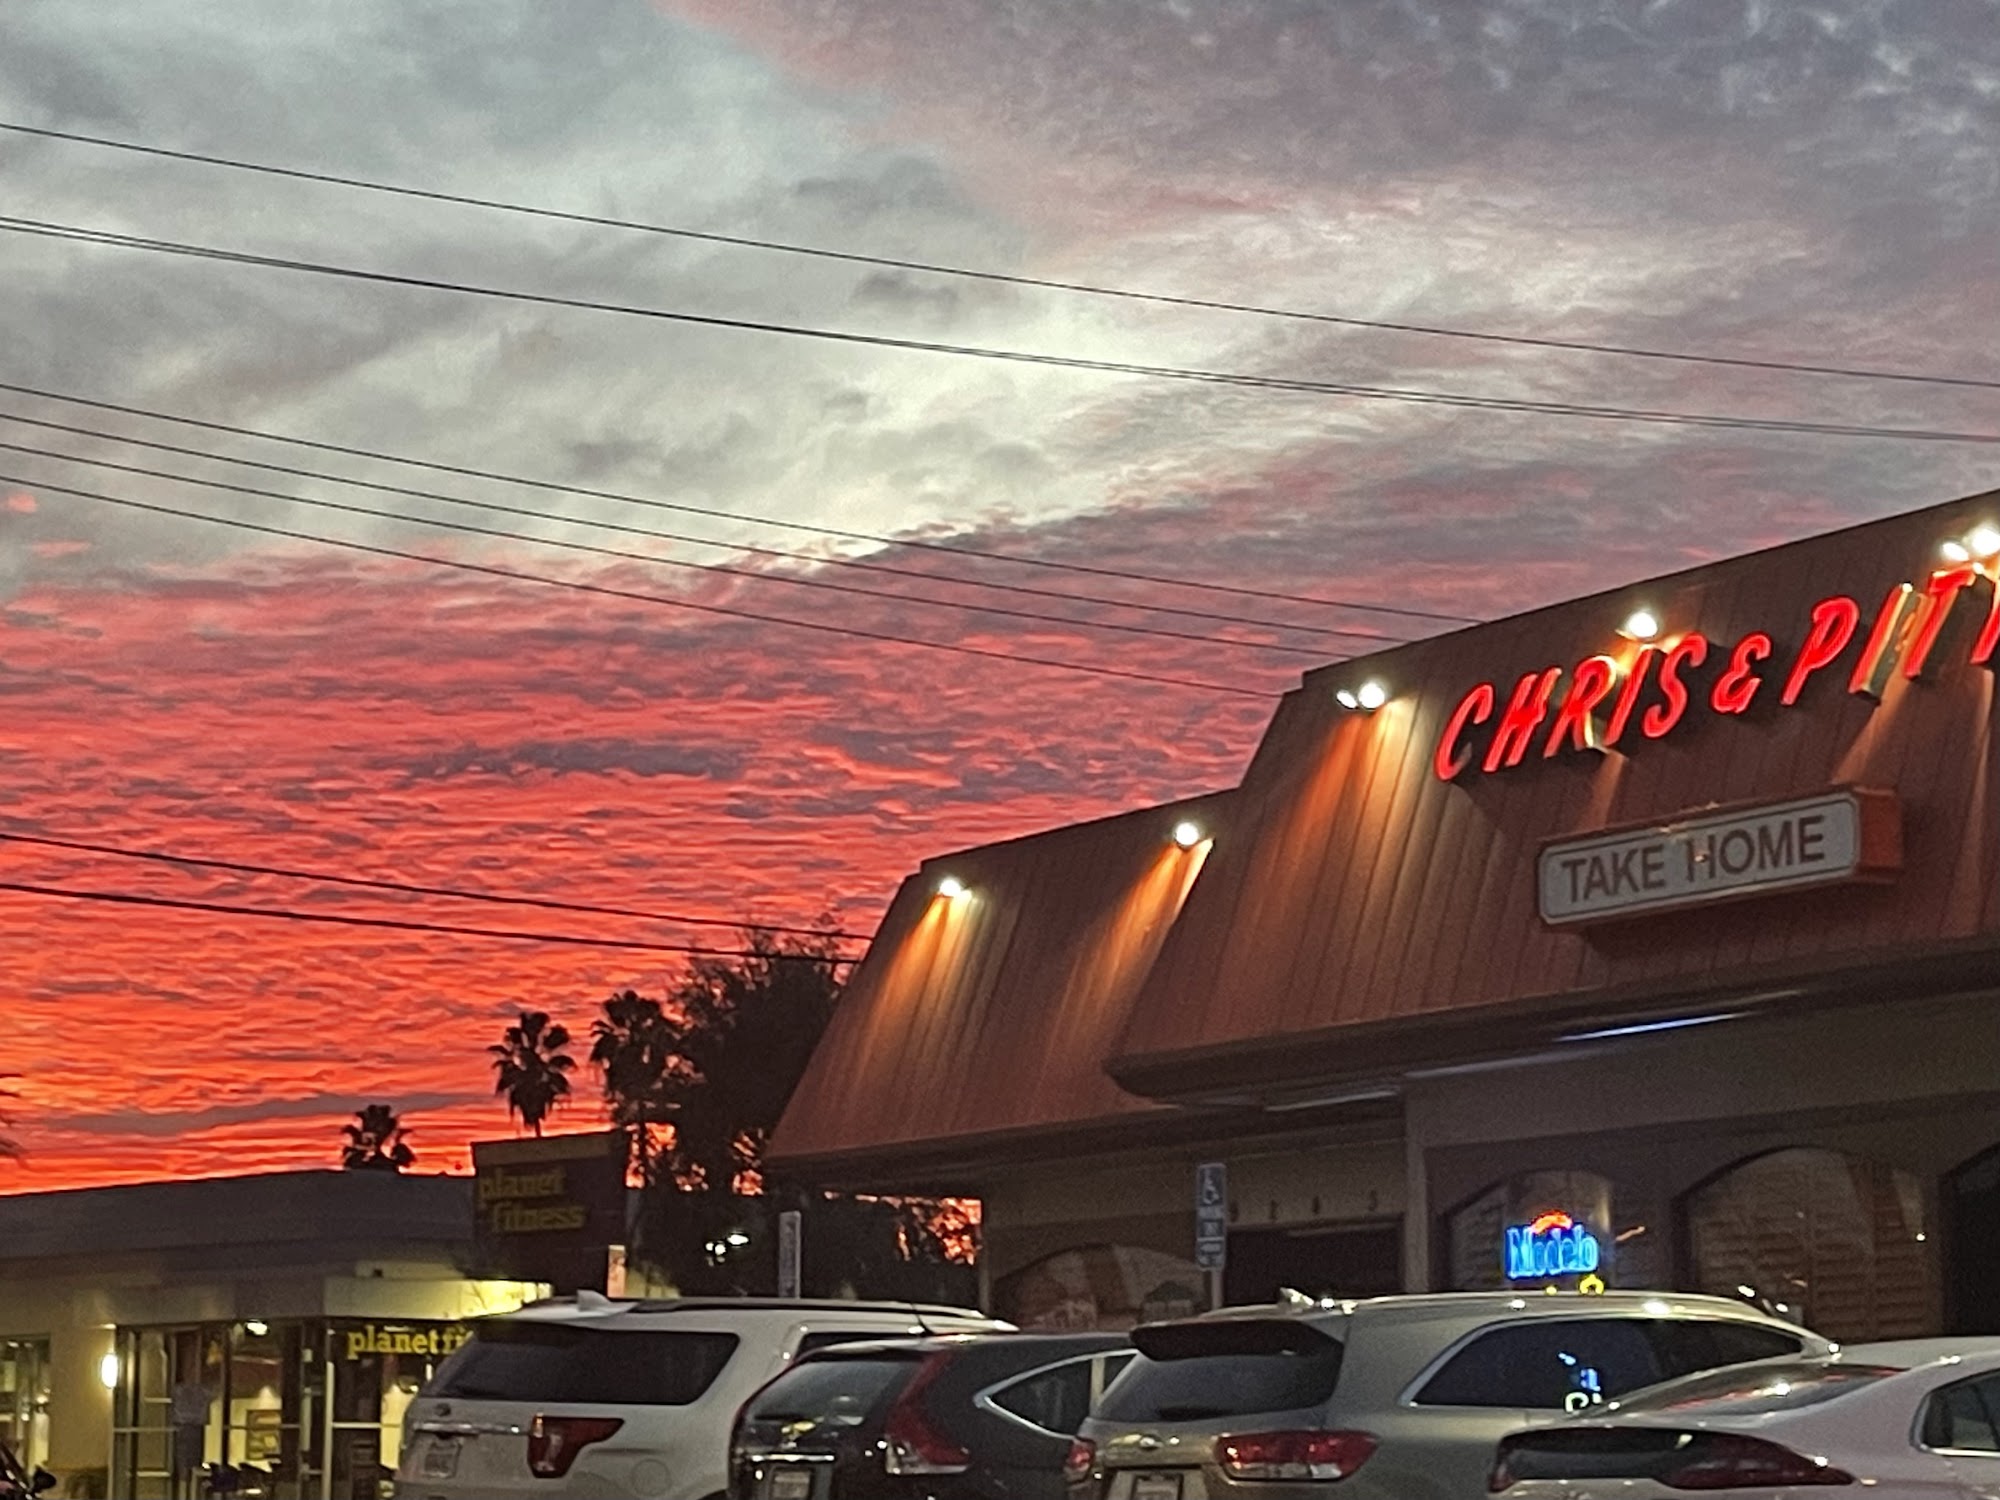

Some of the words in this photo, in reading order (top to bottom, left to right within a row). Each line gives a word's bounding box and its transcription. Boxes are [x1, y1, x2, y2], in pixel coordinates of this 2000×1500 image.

[1433, 630, 1709, 782] CHRIS
[1710, 631, 1772, 714] &
[1560, 843, 1666, 904] TAKE
[1683, 814, 1826, 883] HOME
[478, 1165, 567, 1210] planet
[490, 1201, 588, 1234] fitness
[1505, 1221, 1600, 1279] Modelo
[346, 1323, 439, 1361] planet
